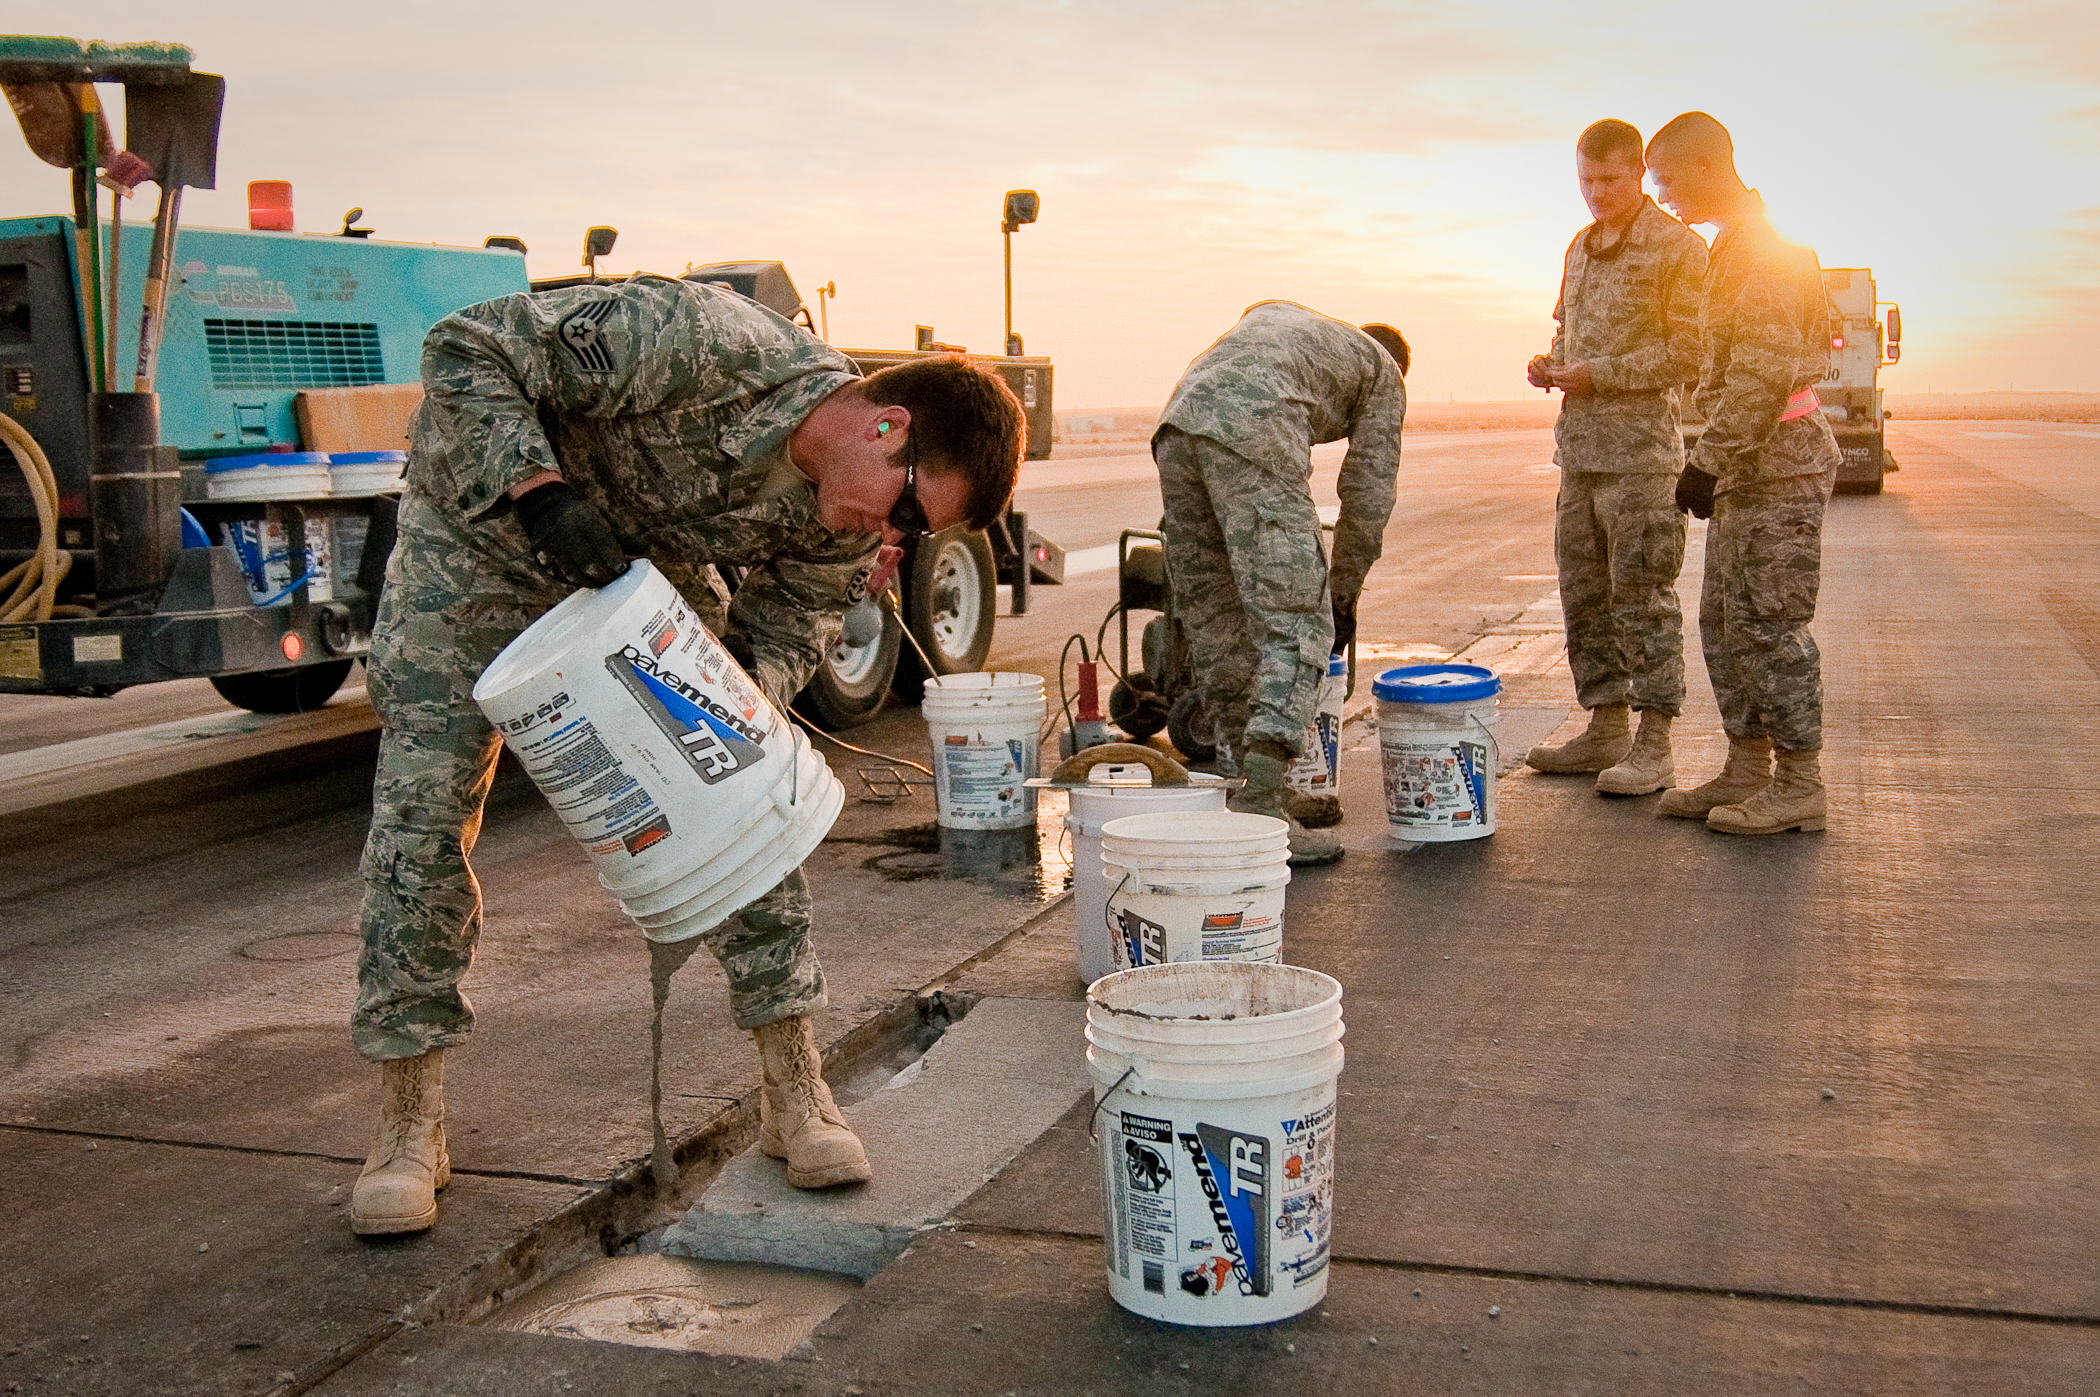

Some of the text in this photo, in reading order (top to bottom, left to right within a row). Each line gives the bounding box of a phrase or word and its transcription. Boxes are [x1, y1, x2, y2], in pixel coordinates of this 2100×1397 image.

[617, 643, 766, 746] pavemend
[676, 717, 740, 780] TR
[1472, 745, 1485, 776] TR
[1451, 746, 1480, 825] pavemend
[1129, 1115, 1171, 1132] WARNING
[1130, 1126, 1157, 1140] AVISO
[1229, 1136, 1263, 1198] TR
[1177, 1132, 1255, 1296] pavemend
